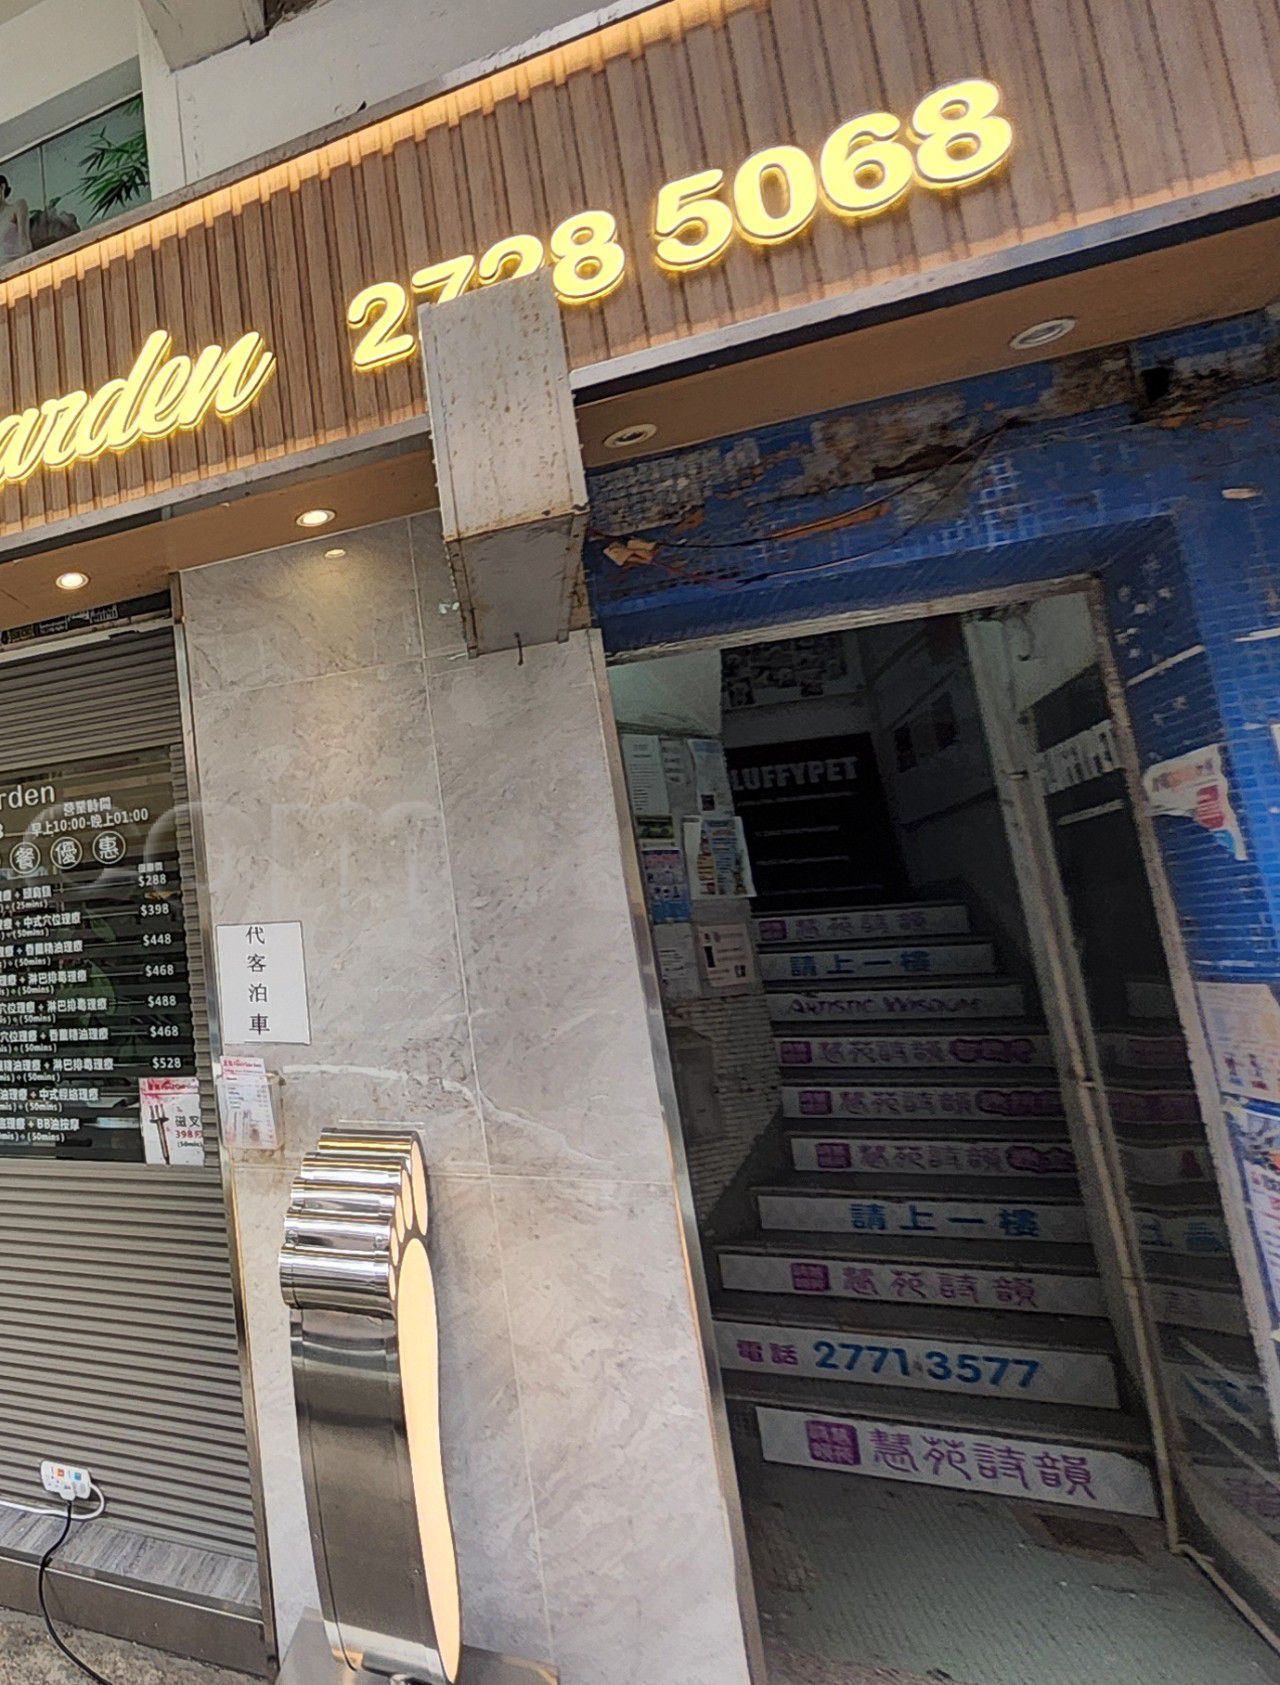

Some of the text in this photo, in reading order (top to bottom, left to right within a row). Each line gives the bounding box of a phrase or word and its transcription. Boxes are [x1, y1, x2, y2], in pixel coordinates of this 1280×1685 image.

[655, 79, 1013, 270] 5068
[138, 873, 167, 887] $288
[140, 903, 169, 916] $398
[143, 933, 172, 946] $448
[145, 965, 174, 977] $468
[246, 926, 270, 1035] 代客泊車
[148, 995, 176, 1007] $488
[150, 1026, 179, 1038] $468
[152, 1057, 181, 1069] $528
[850, 1203, 1040, 1237] 請上一樓
[736, 1339, 1043, 1388] 電話 2771 3577
[870, 1428, 1096, 1500] 慧苑詩韻
